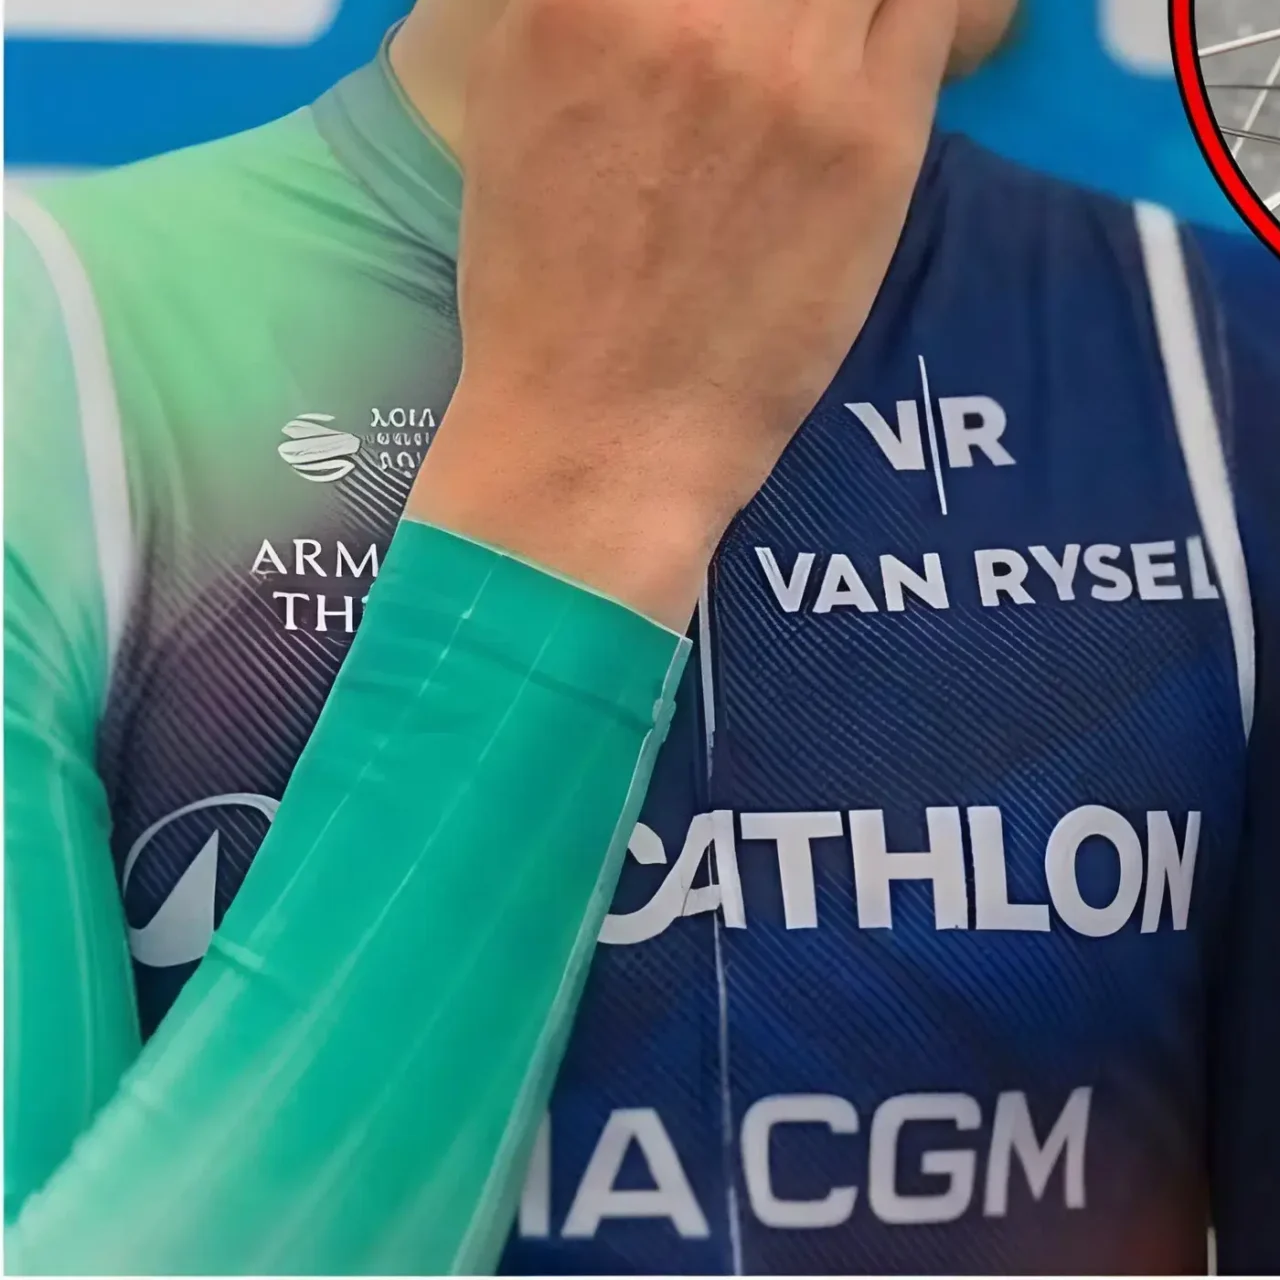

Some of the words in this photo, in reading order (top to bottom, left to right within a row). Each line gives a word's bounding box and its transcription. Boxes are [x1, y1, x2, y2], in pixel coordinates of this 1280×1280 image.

[272, 590, 370, 633] TH
[754, 545, 950, 614] VAN
[973, 534, 1222, 607] RYSEL
[740, 1086, 1093, 1229] CGM
